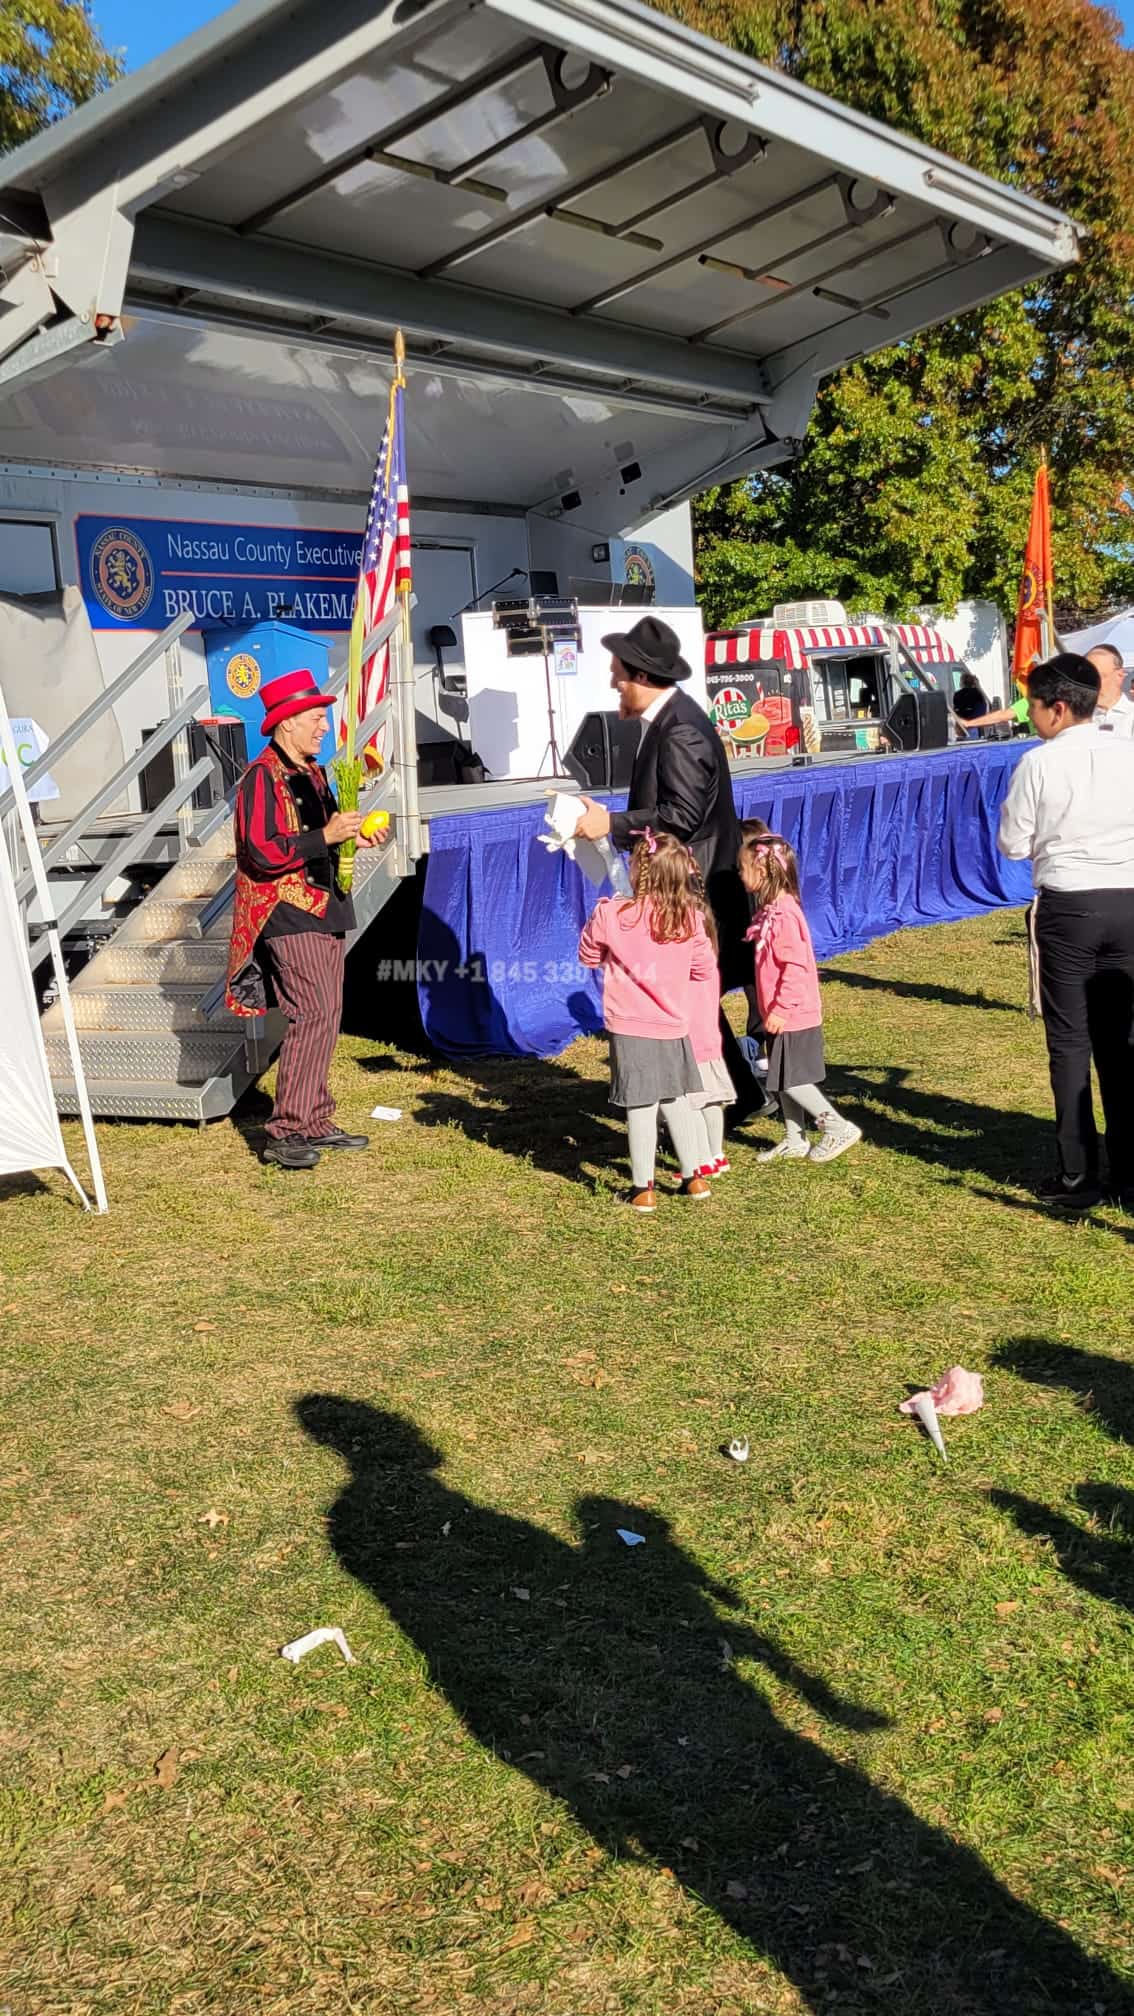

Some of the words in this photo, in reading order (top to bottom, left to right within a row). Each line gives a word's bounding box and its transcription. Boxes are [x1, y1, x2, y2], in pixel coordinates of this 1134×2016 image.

[167, 533, 230, 560] Nassau
[234, 537, 291, 569] County
[296, 540, 363, 567] Executive
[163, 589, 235, 618] BRUCE
[241, 592, 261, 619] A.
